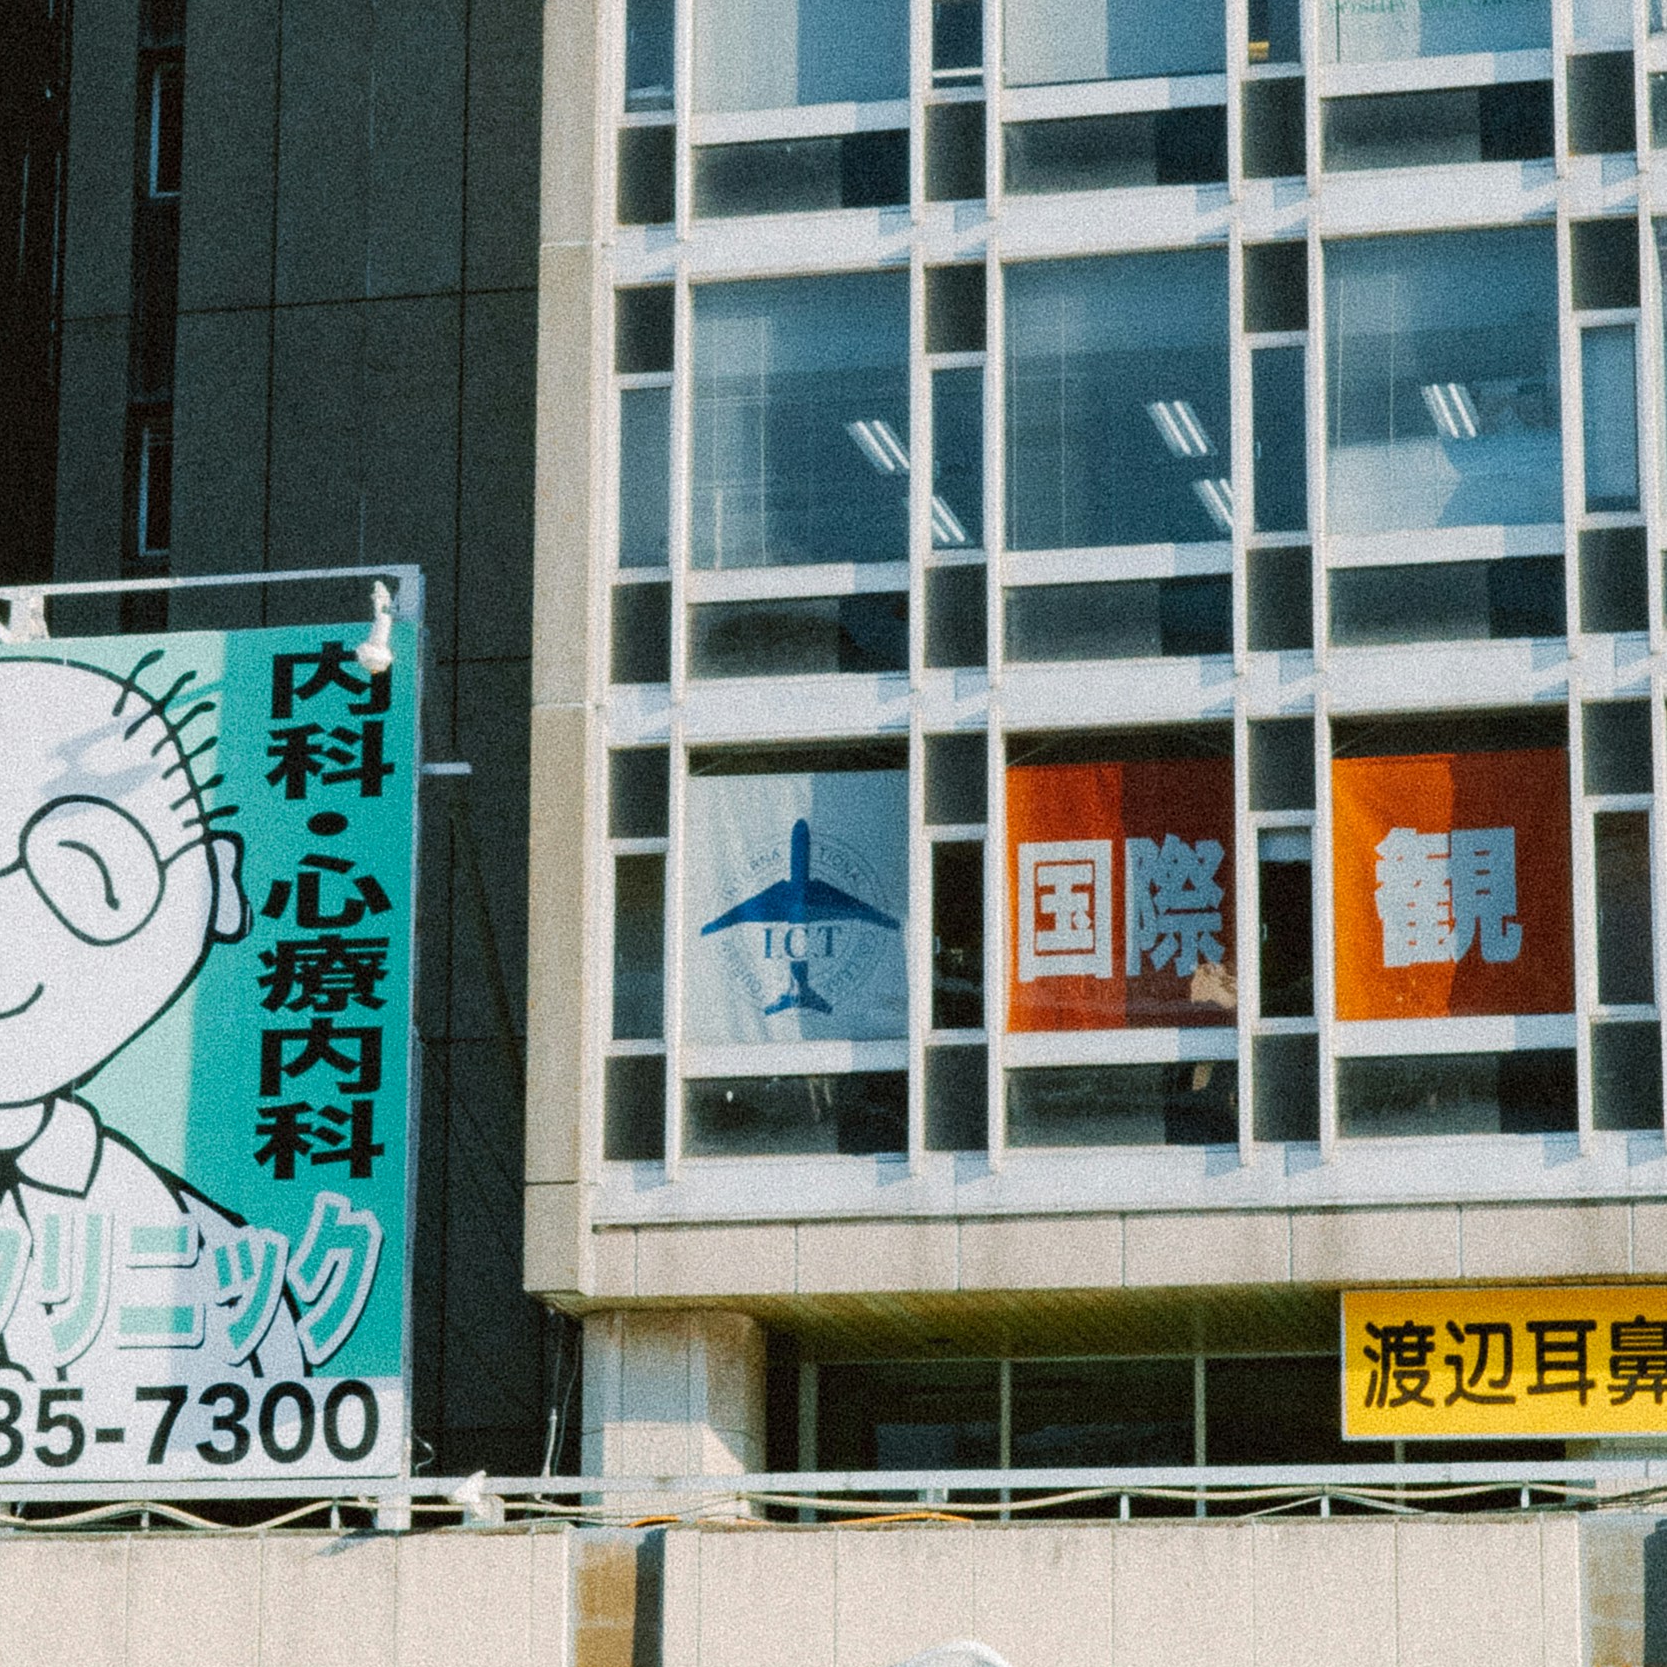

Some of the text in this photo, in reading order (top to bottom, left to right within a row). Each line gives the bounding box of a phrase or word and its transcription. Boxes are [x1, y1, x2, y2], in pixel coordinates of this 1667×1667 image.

[253, 640, 397, 1182] 内科・心療内科
[1016, 823, 1524, 985] 国際 観
[1363, 1314, 1667, 1408] 渡辺耳鼻
